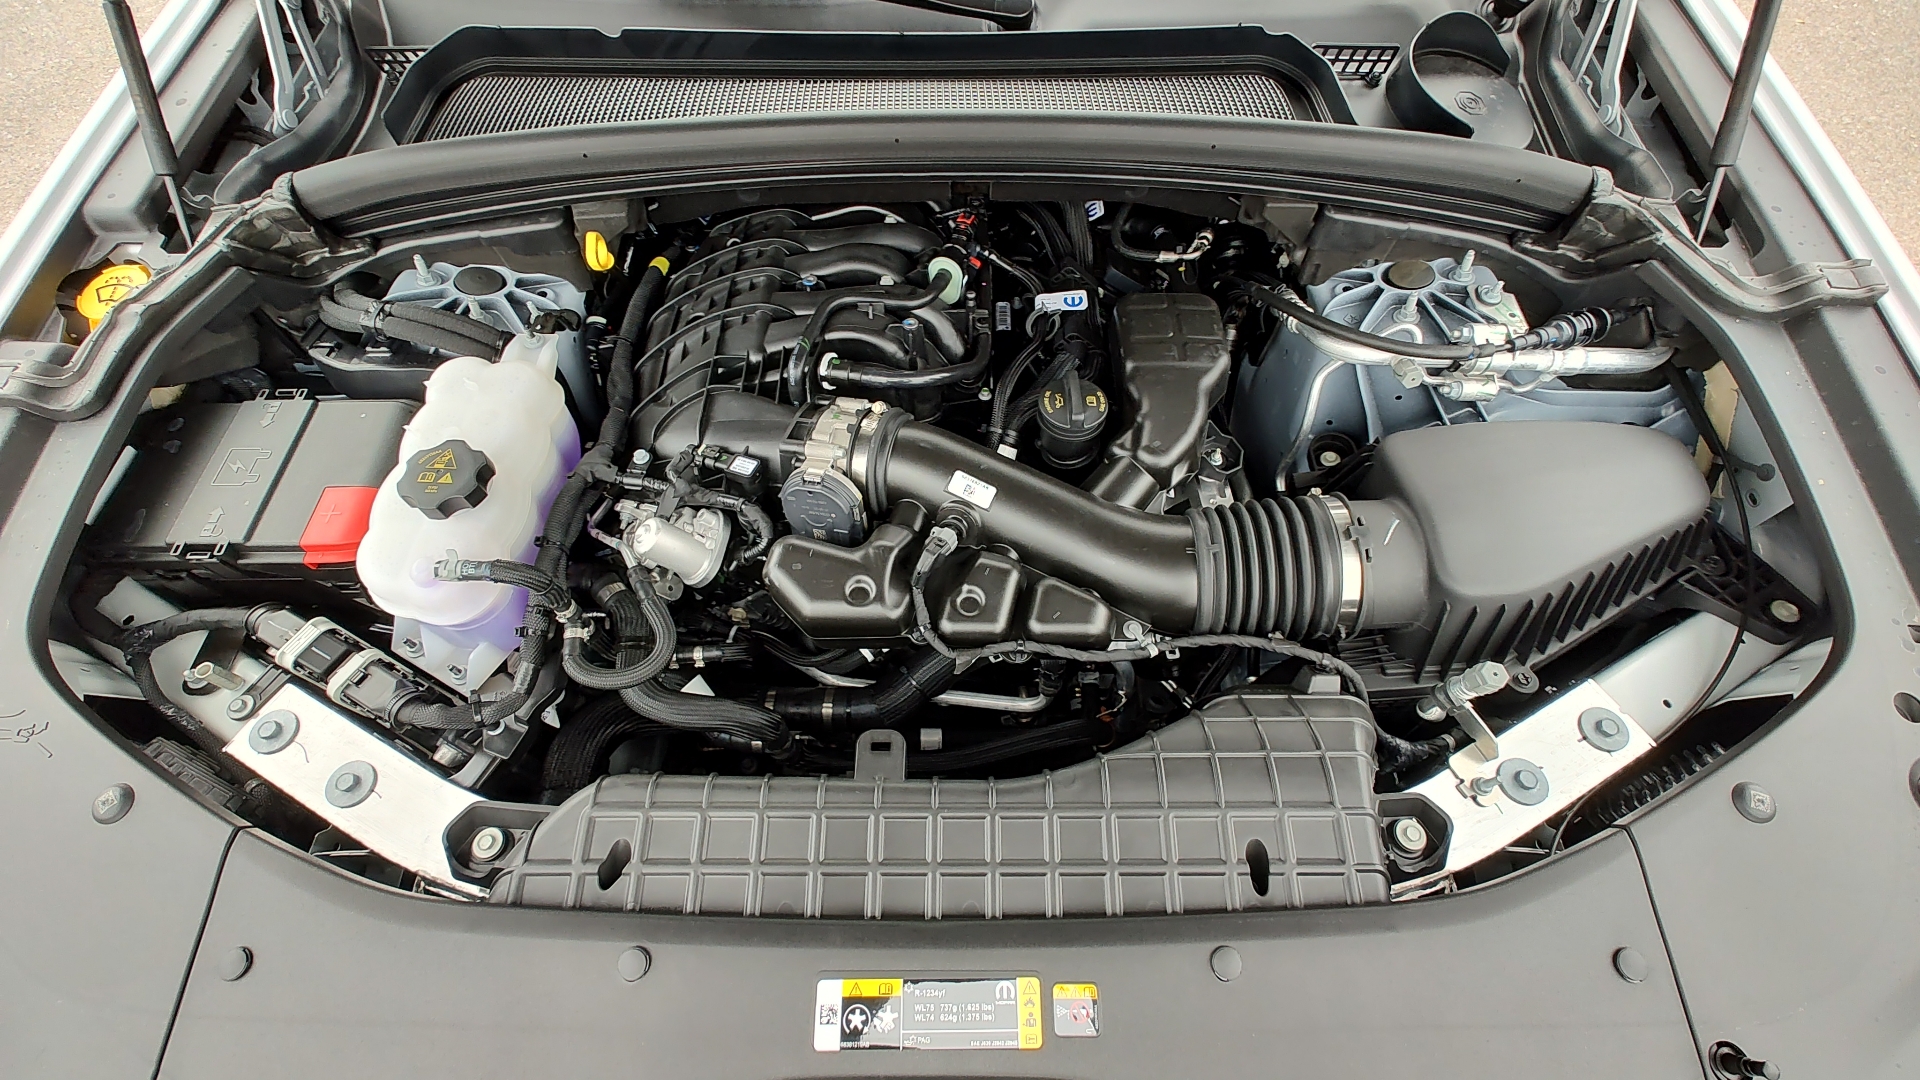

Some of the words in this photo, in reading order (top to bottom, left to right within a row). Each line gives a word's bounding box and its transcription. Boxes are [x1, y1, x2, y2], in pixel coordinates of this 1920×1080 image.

[1044, 390, 1052, 398] OIL
[1043, 397, 1054, 414] ENGINE
[914, 988, 946, 999] R-1234yf
[914, 1003, 935, 1012] WL75
[940, 1003, 958, 1013] 737g
[958, 1003, 980, 1013] (1.625
[981, 1003, 995, 1013] lbs)
[914, 1013, 935, 1022] WL74
[939, 1013, 957, 1023] 624g
[958, 1013, 980, 1023] (1.375
[981, 1013, 995, 1023] lbs)
[917, 1036, 931, 1044] PAG
